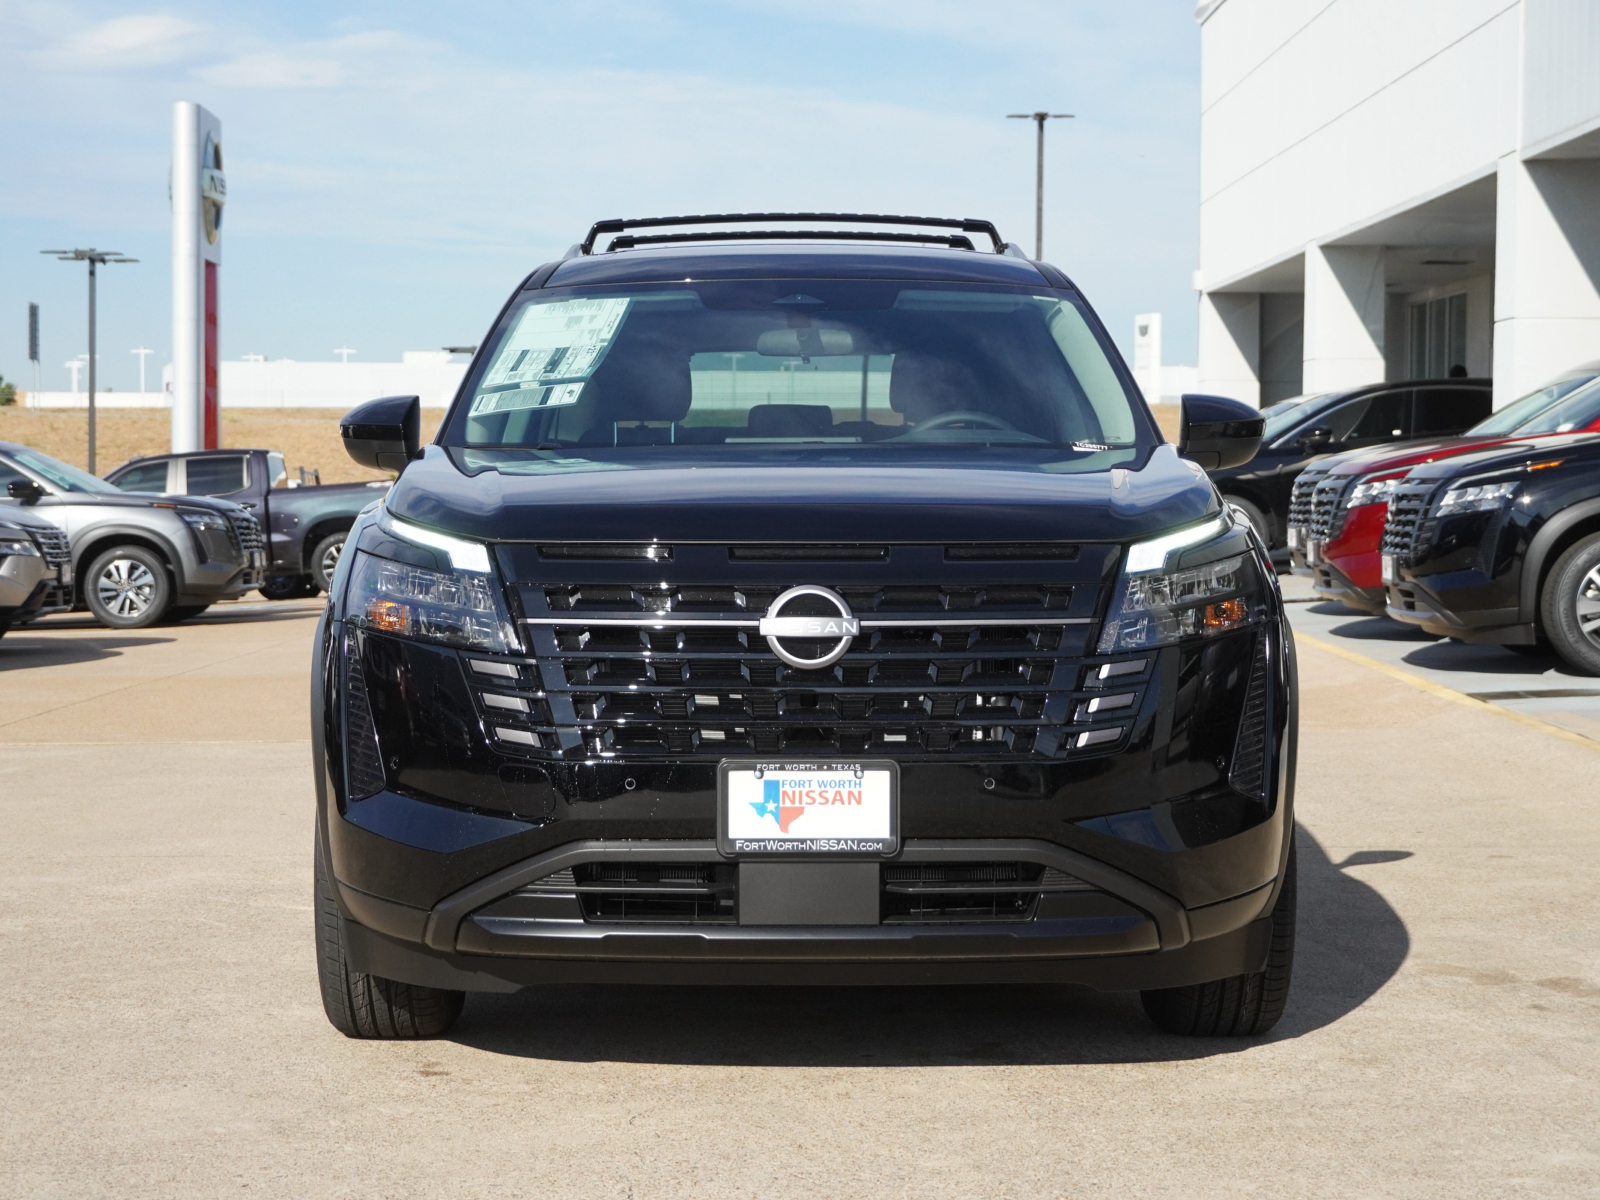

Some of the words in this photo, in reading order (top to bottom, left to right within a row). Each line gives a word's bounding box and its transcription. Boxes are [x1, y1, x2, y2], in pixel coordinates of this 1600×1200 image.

[781, 779, 813, 789] FORT
[817, 779, 862, 789] WORTH
[781, 790, 862, 805] NISSAN
